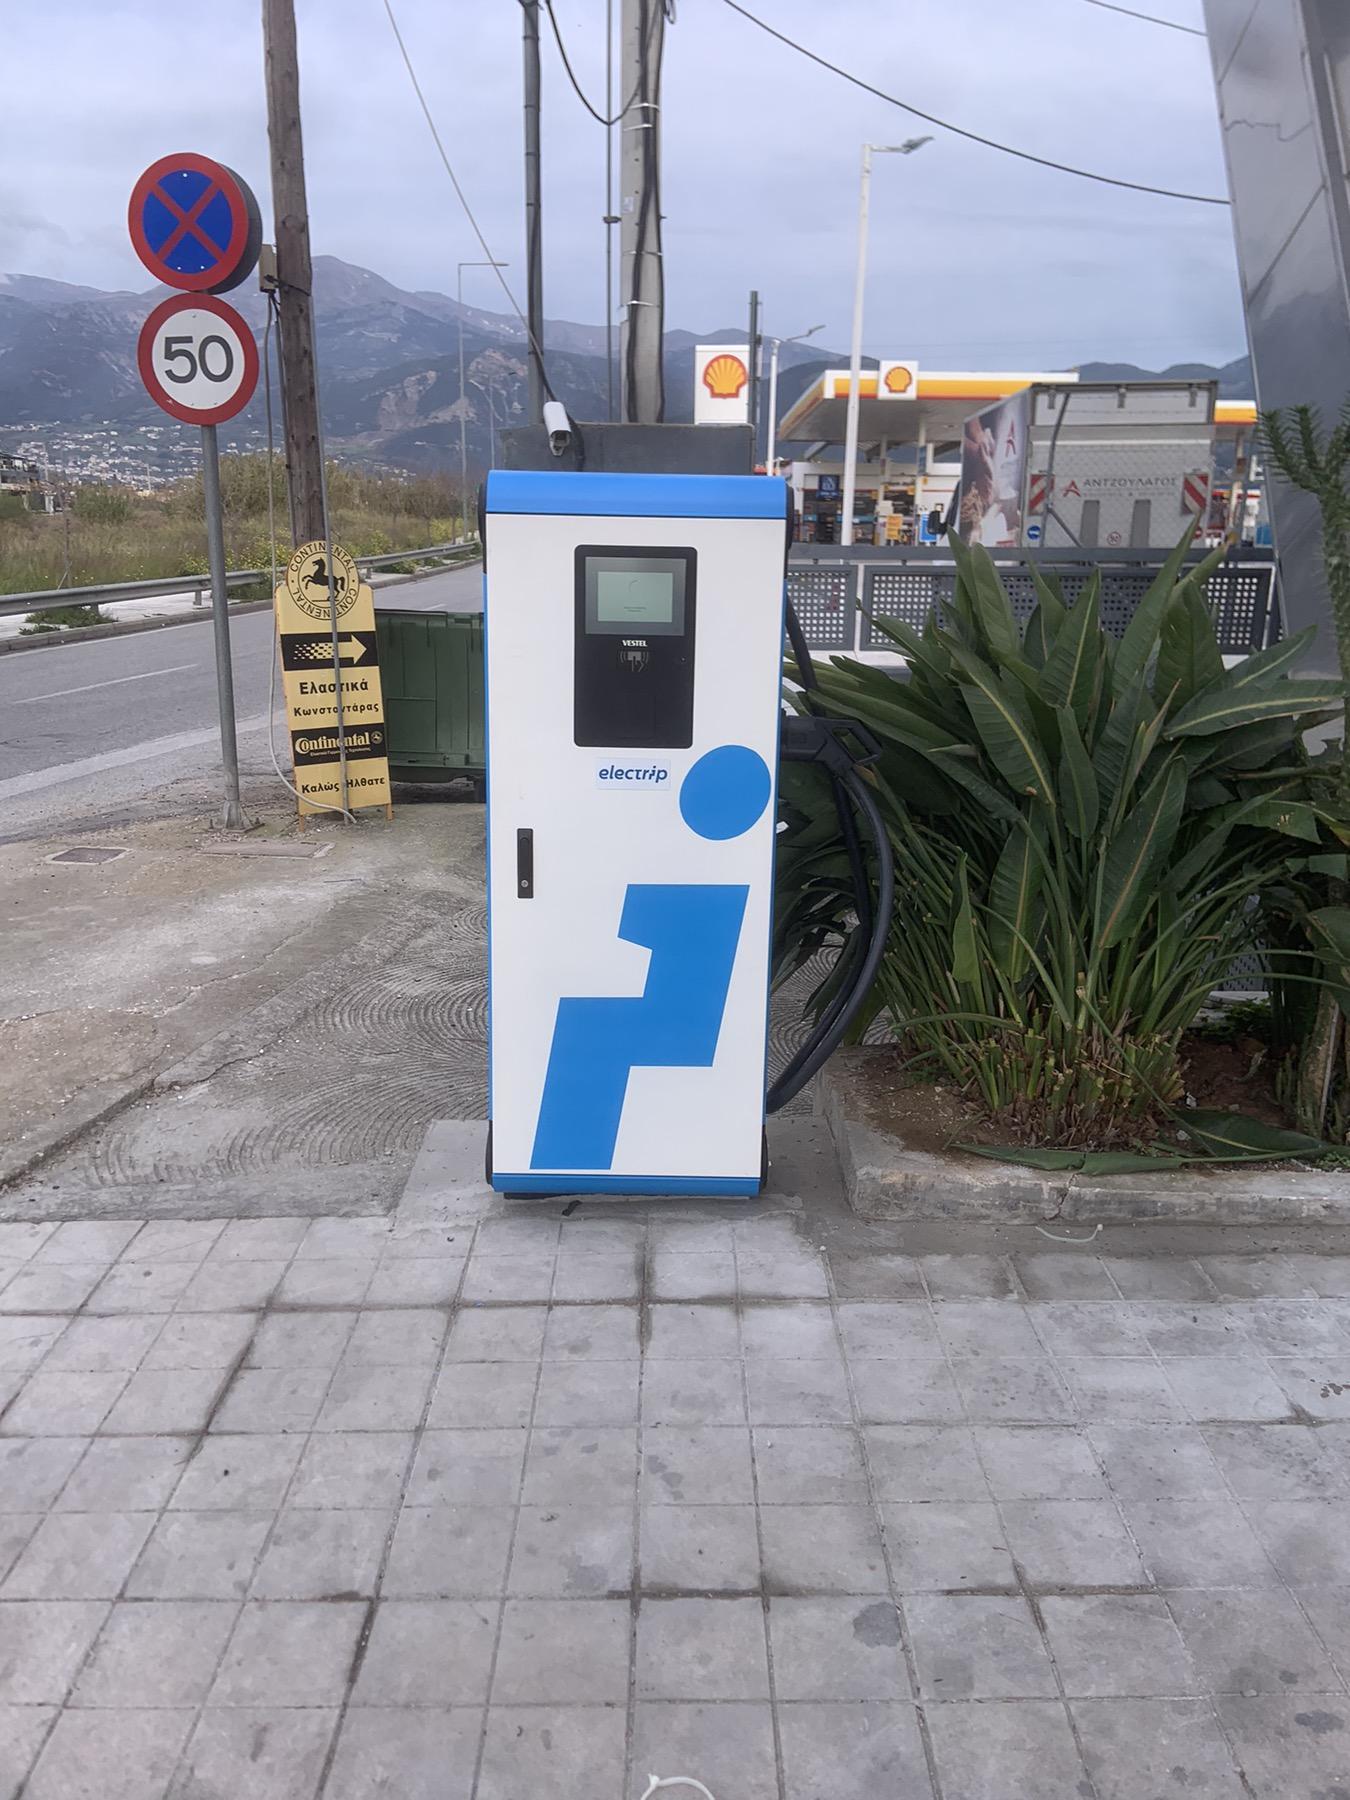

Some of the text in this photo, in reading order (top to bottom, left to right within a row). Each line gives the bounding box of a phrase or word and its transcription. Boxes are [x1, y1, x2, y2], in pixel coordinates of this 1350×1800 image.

[163, 335, 234, 384] 50
[293, 587, 357, 618] CONTNENTAL
[622, 639, 648, 647] VESTEL
[299, 678, 369, 695] Ελαστικά
[598, 764, 668, 783] electrip
[301, 781, 340, 794] Καλώς
